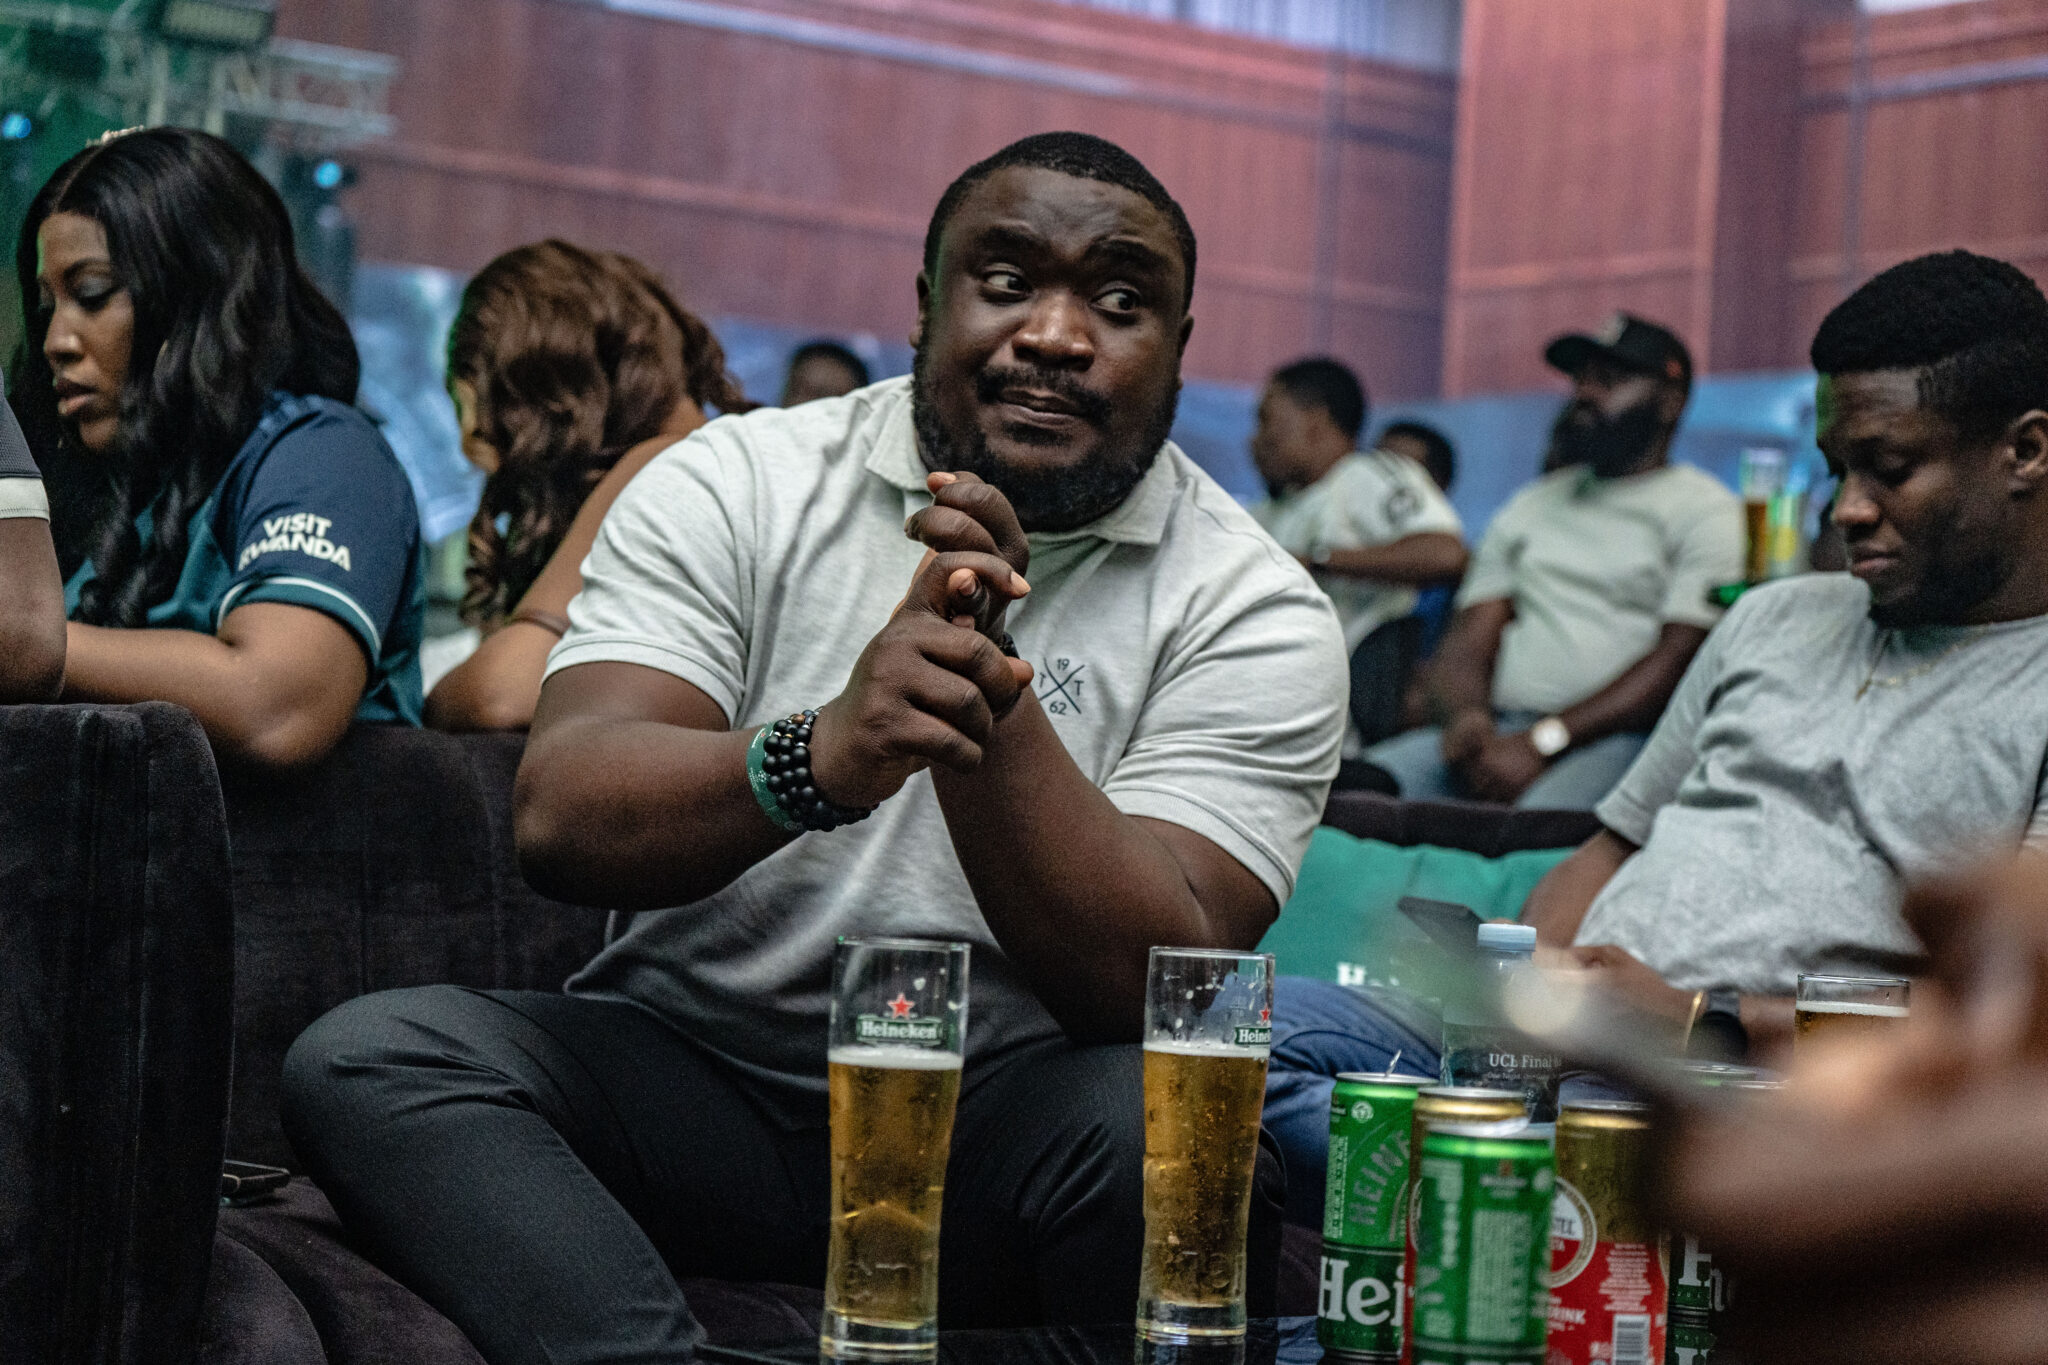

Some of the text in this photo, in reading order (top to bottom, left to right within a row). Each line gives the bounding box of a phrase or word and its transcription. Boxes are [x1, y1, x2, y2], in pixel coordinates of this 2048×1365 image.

[263, 513, 332, 538] VISIT
[1057, 658, 1070, 670] 19
[1049, 701, 1067, 715] 62
[861, 1020, 937, 1039] Heineken
[1488, 1053, 1518, 1068] UCL
